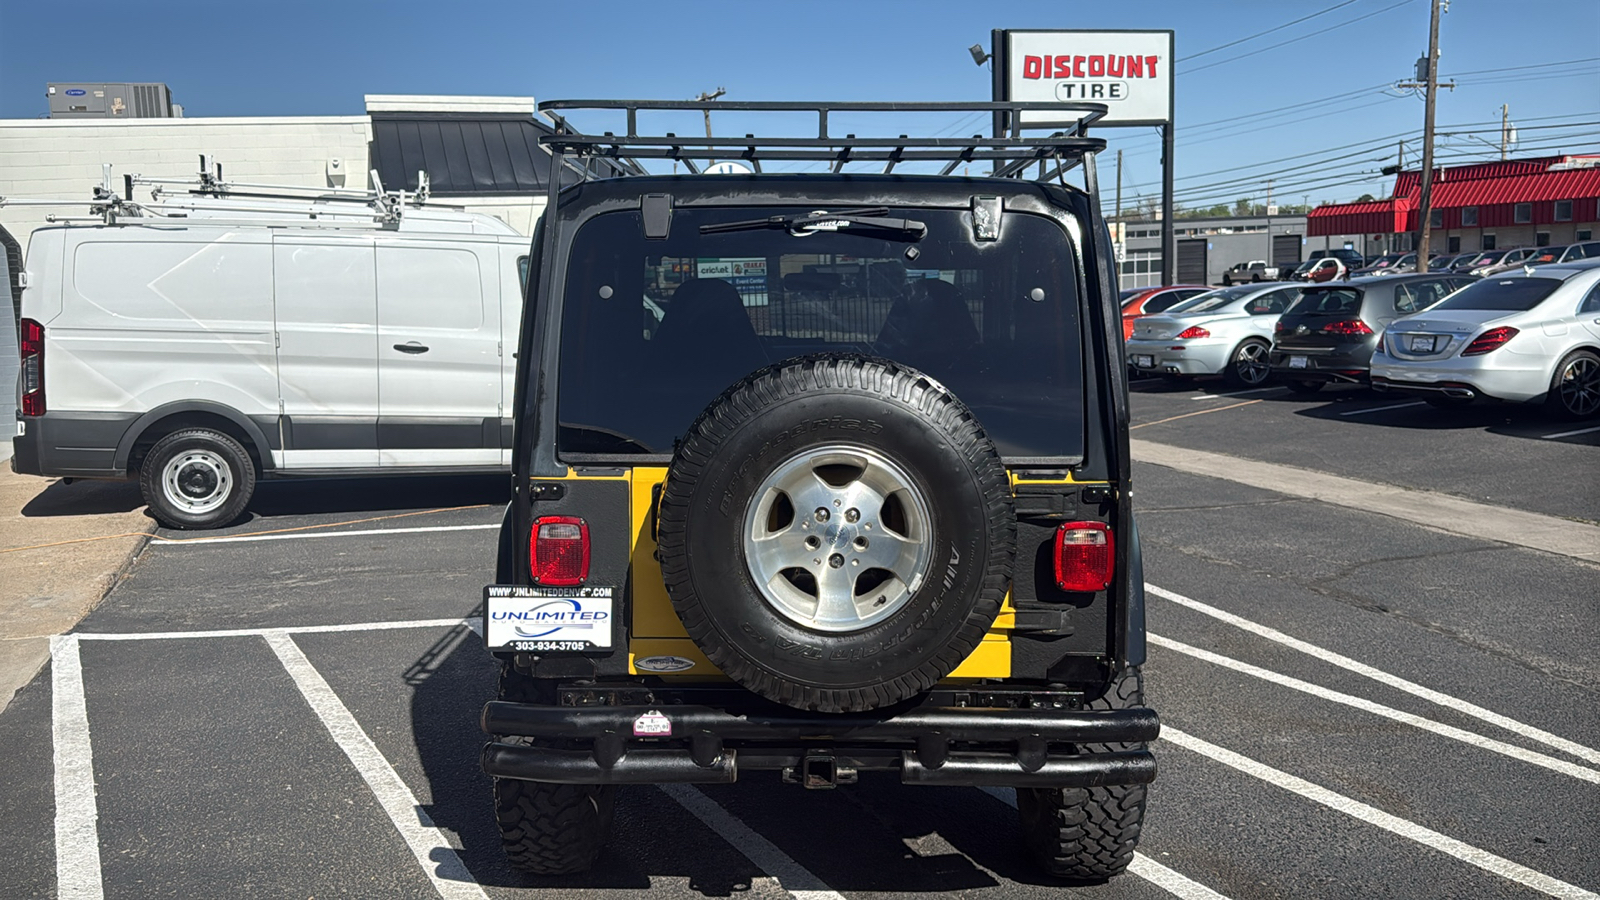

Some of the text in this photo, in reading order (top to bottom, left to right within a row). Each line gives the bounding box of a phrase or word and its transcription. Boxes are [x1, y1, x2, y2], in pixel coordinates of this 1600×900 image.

[1023, 54, 1158, 80] DISCOUNT
[1063, 84, 1120, 98] TIRE
[701, 265, 729, 274] cricket
[488, 587, 612, 597] WWWUNLIMITEDDENVER.COM
[492, 611, 608, 620] UNLIMITED
[515, 642, 584, 650] 303-934-3705
